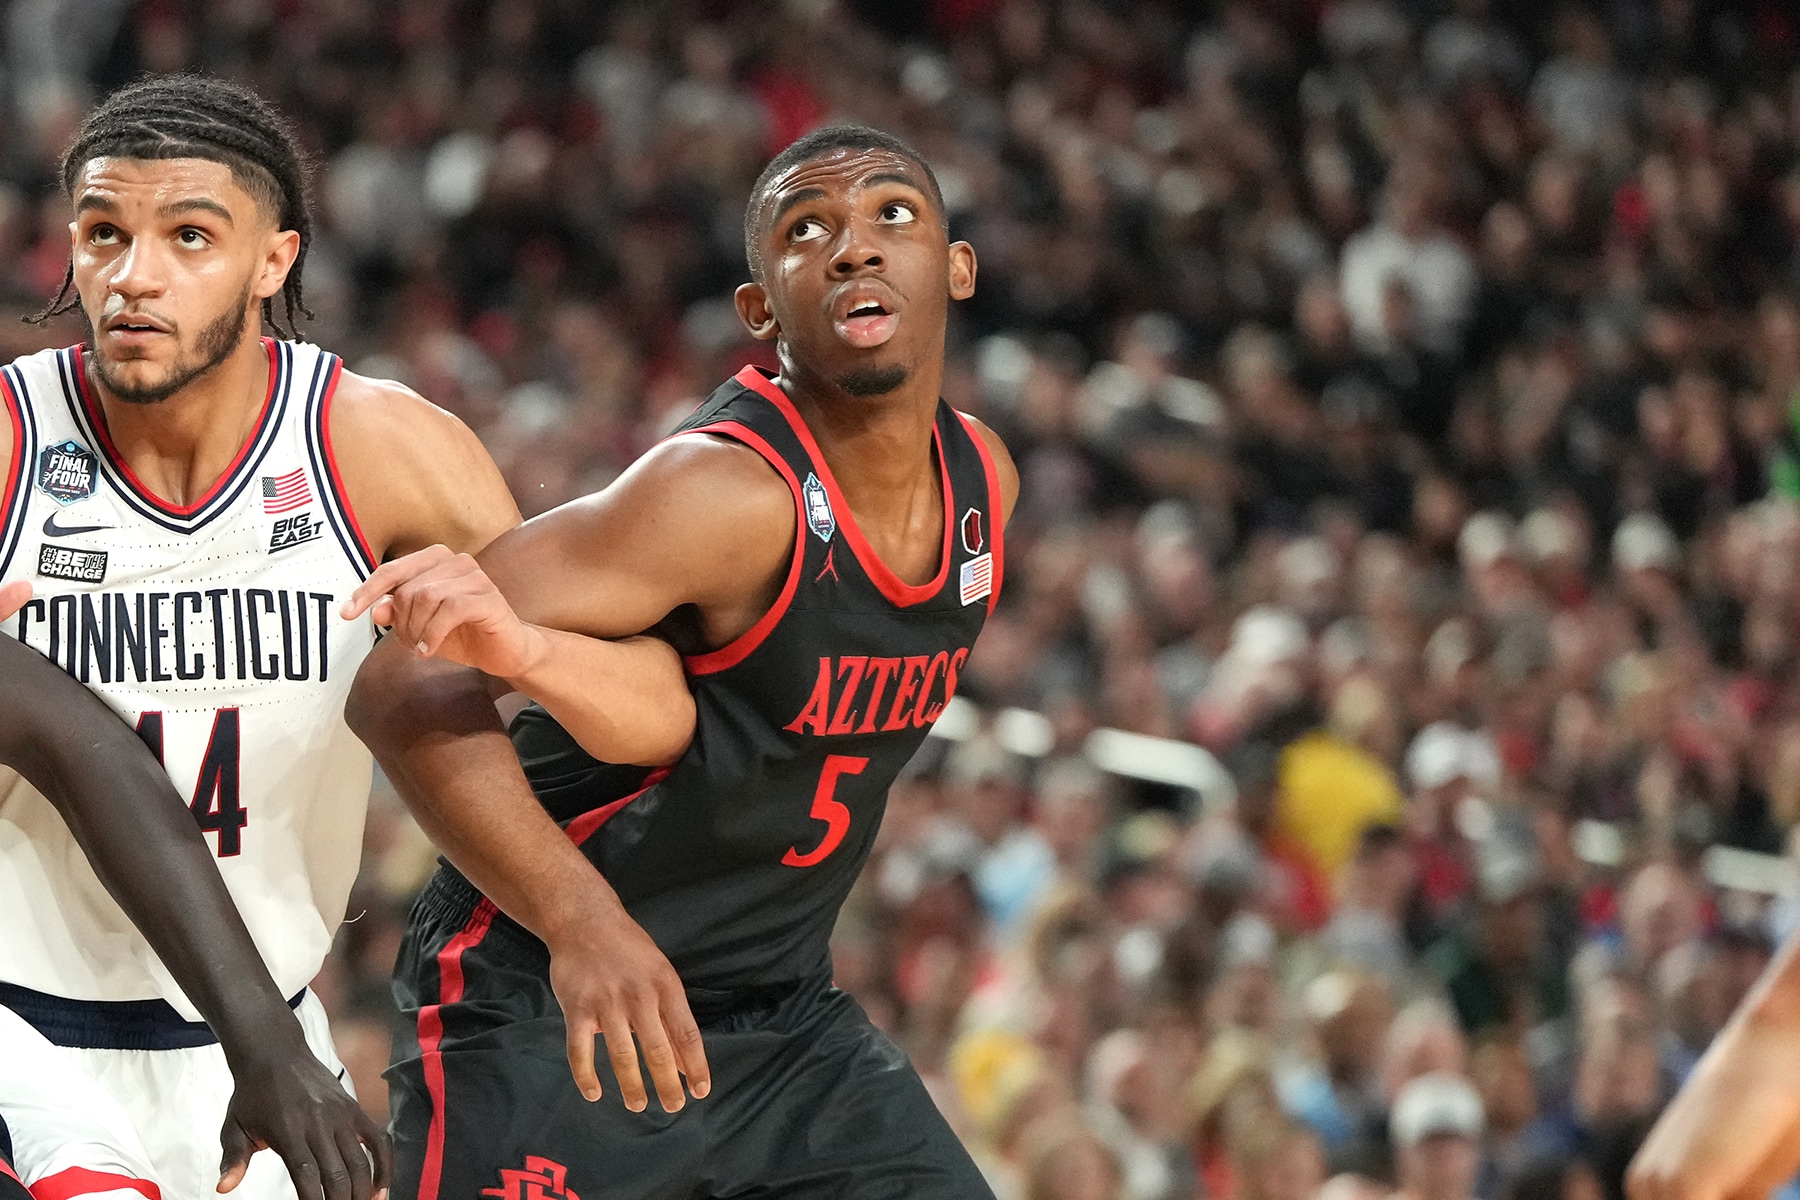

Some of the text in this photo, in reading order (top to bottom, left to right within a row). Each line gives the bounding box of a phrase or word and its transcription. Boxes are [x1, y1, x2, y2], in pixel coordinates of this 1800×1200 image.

[49, 454, 89, 473] FINAL
[51, 470, 91, 488] FOUR
[270, 521, 324, 547] EAST
[272, 512, 311, 534] BIG
[40, 563, 104, 580] CHANGE
[782, 647, 969, 737] AZTECS
[781, 753, 871, 868] 5
